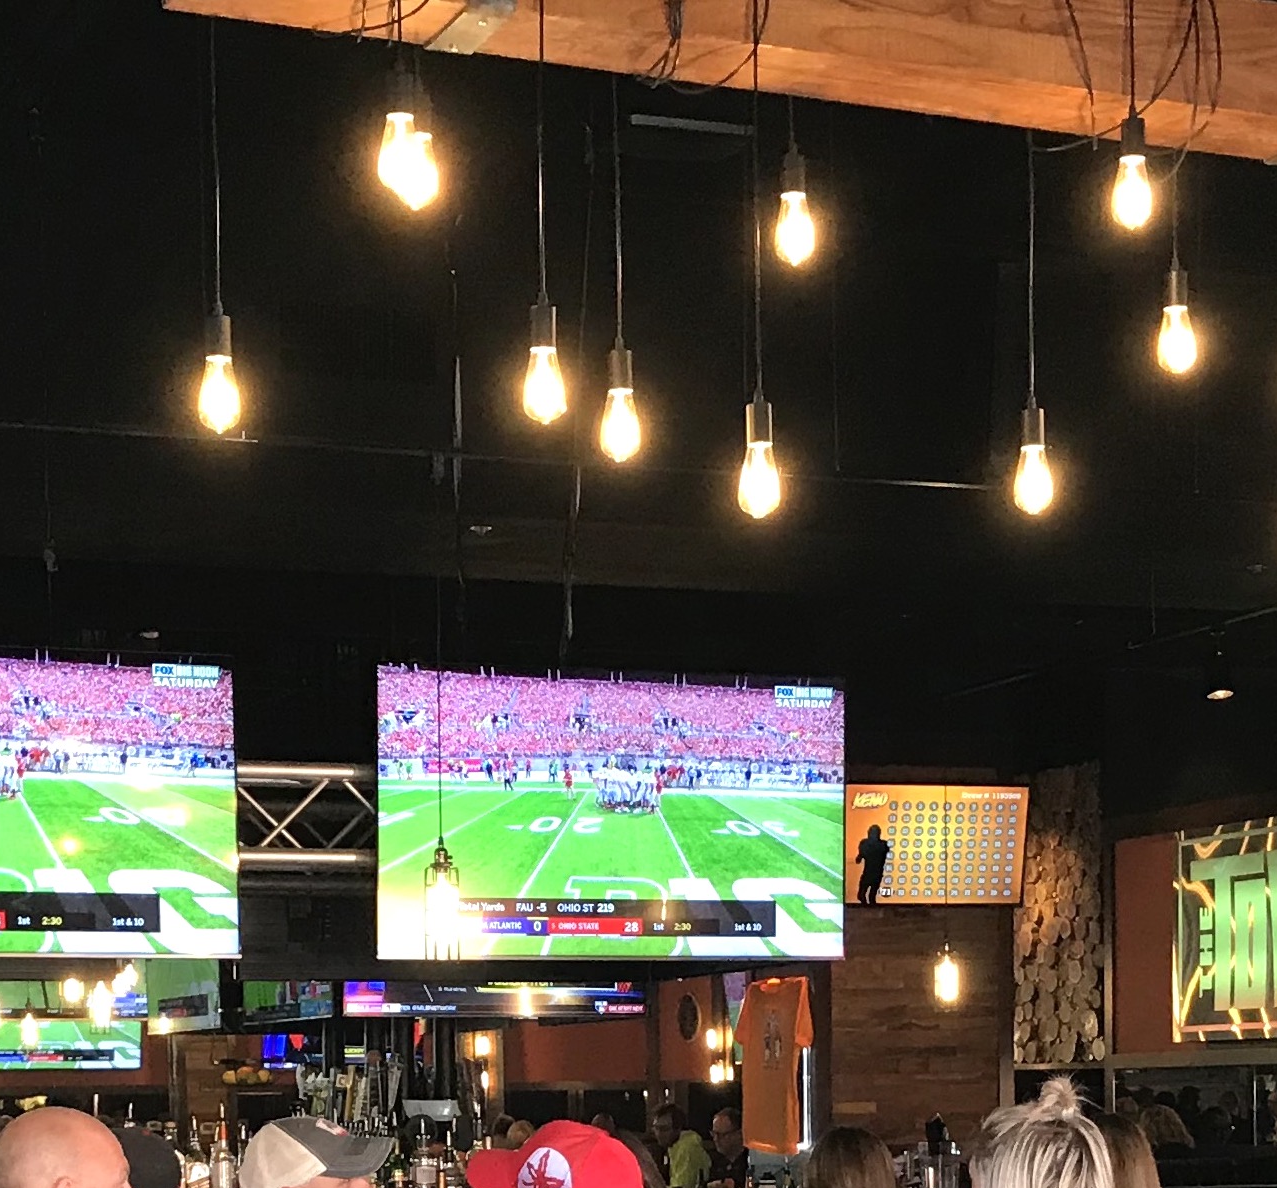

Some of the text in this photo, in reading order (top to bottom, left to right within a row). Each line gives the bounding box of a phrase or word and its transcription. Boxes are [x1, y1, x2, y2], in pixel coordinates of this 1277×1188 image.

[154, 665, 174, 675] FOX
[153, 677, 219, 689] SATURDAY
[776, 687, 794, 697] FOX
[775, 698, 833, 709] SATURDAY
[852, 792, 889, 809] KENO
[458, 902, 615, 913] otal Yards FAU -5 OHIO ST 219
[17, 915, 63, 926] 1st 2:30
[112, 917, 145, 927] 1st & 10
[489, 921, 522, 930] ATLANTIC
[533, 920, 542, 932] 0
[653, 921, 692, 931] 1st 2:30
[558, 922, 577, 931] OHIO
[578, 922, 600, 931] STATE
[624, 922, 639, 933] 28
[1198, 907, 1214, 998] THE
